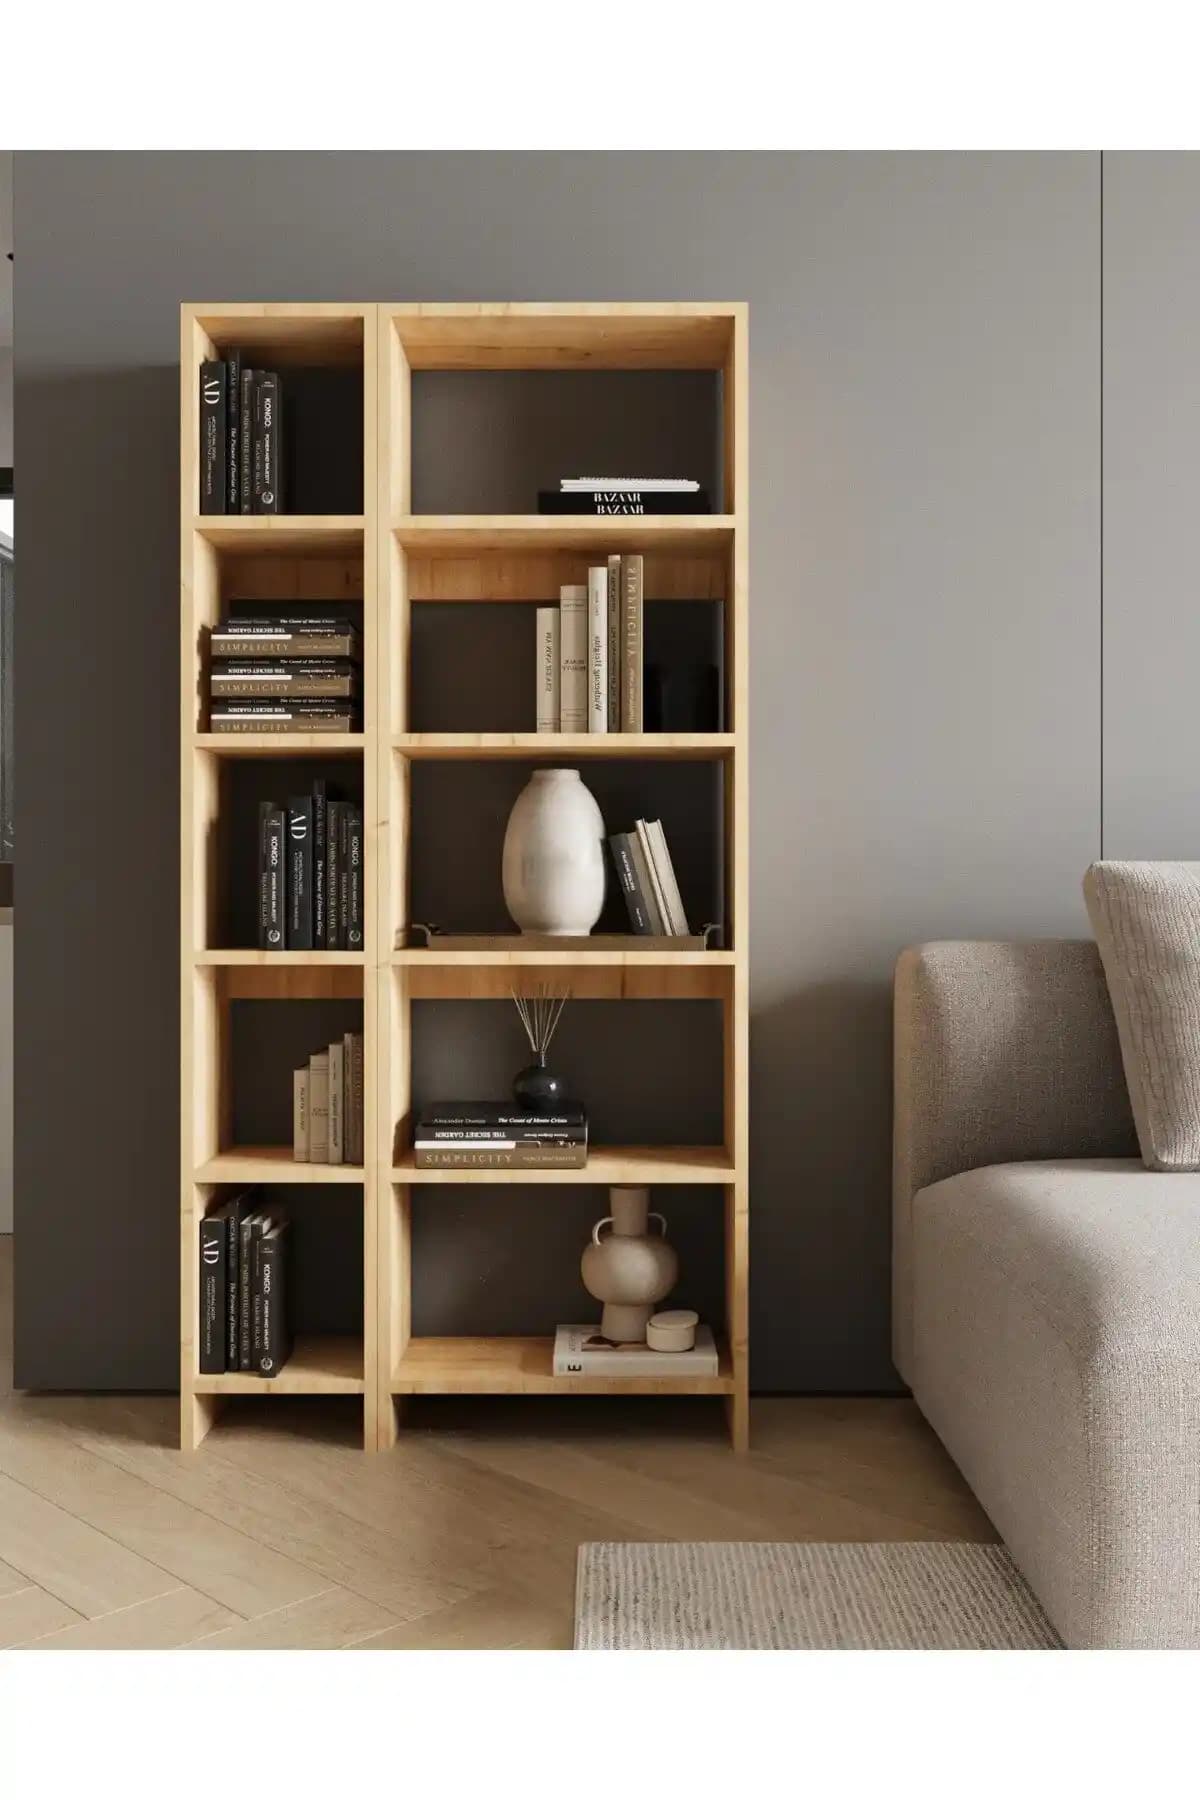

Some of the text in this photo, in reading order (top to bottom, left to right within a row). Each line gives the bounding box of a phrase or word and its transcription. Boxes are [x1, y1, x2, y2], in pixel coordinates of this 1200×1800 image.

[204, 375, 220, 404] AD
[594, 493, 641, 502] BAZAAR
[597, 505, 644, 514] BAZAAR
[220, 684, 289, 692] SIMPLICITY
[290, 810, 306, 839] AD
[425, 1154, 512, 1163] SIMPLICITY
[203, 1235, 219, 1264] AD
